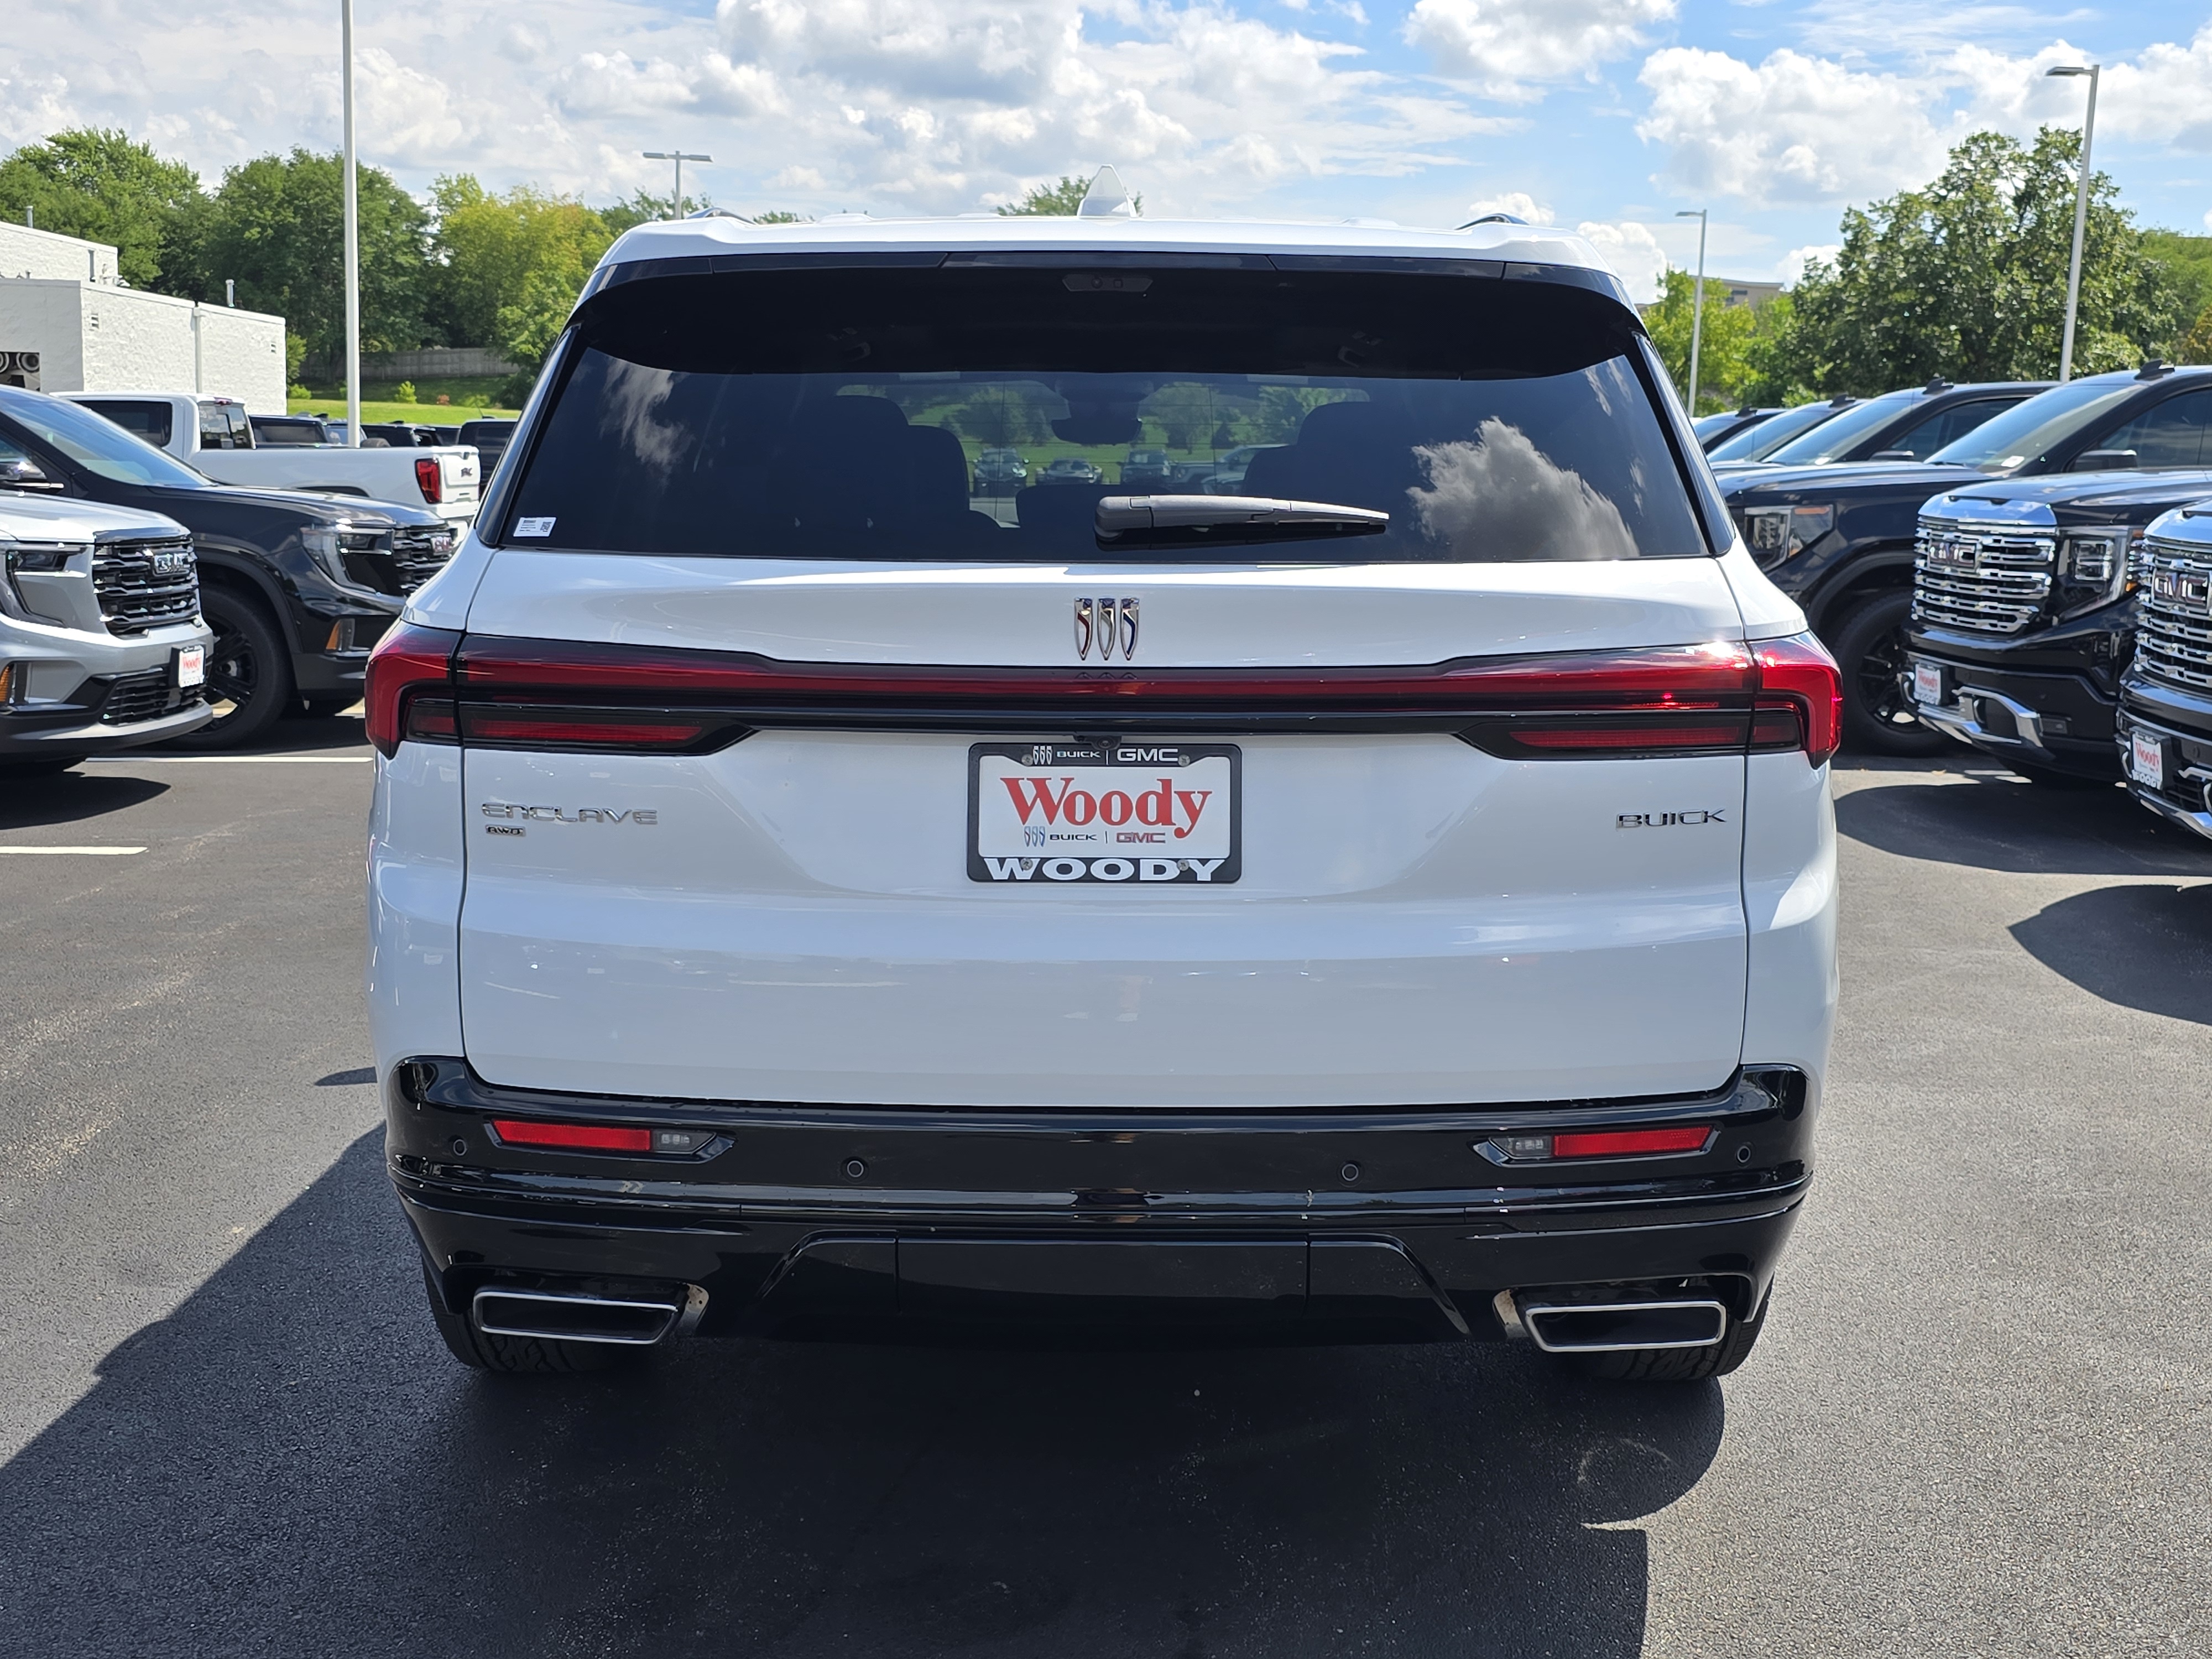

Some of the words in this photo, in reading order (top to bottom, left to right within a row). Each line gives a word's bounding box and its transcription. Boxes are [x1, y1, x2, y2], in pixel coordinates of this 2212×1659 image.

[2154, 572, 2208, 606] GMC
[1117, 748, 1178, 761] GMC
[2135, 742, 2159, 772] Woody
[482, 802, 658, 825] ENCLAVE
[1000, 777, 1212, 838] Woody
[1616, 808, 1727, 830] BUICK
[487, 826, 524, 836] AWD
[1116, 832, 1166, 843] GMC
[984, 858, 1224, 881] WOODY
